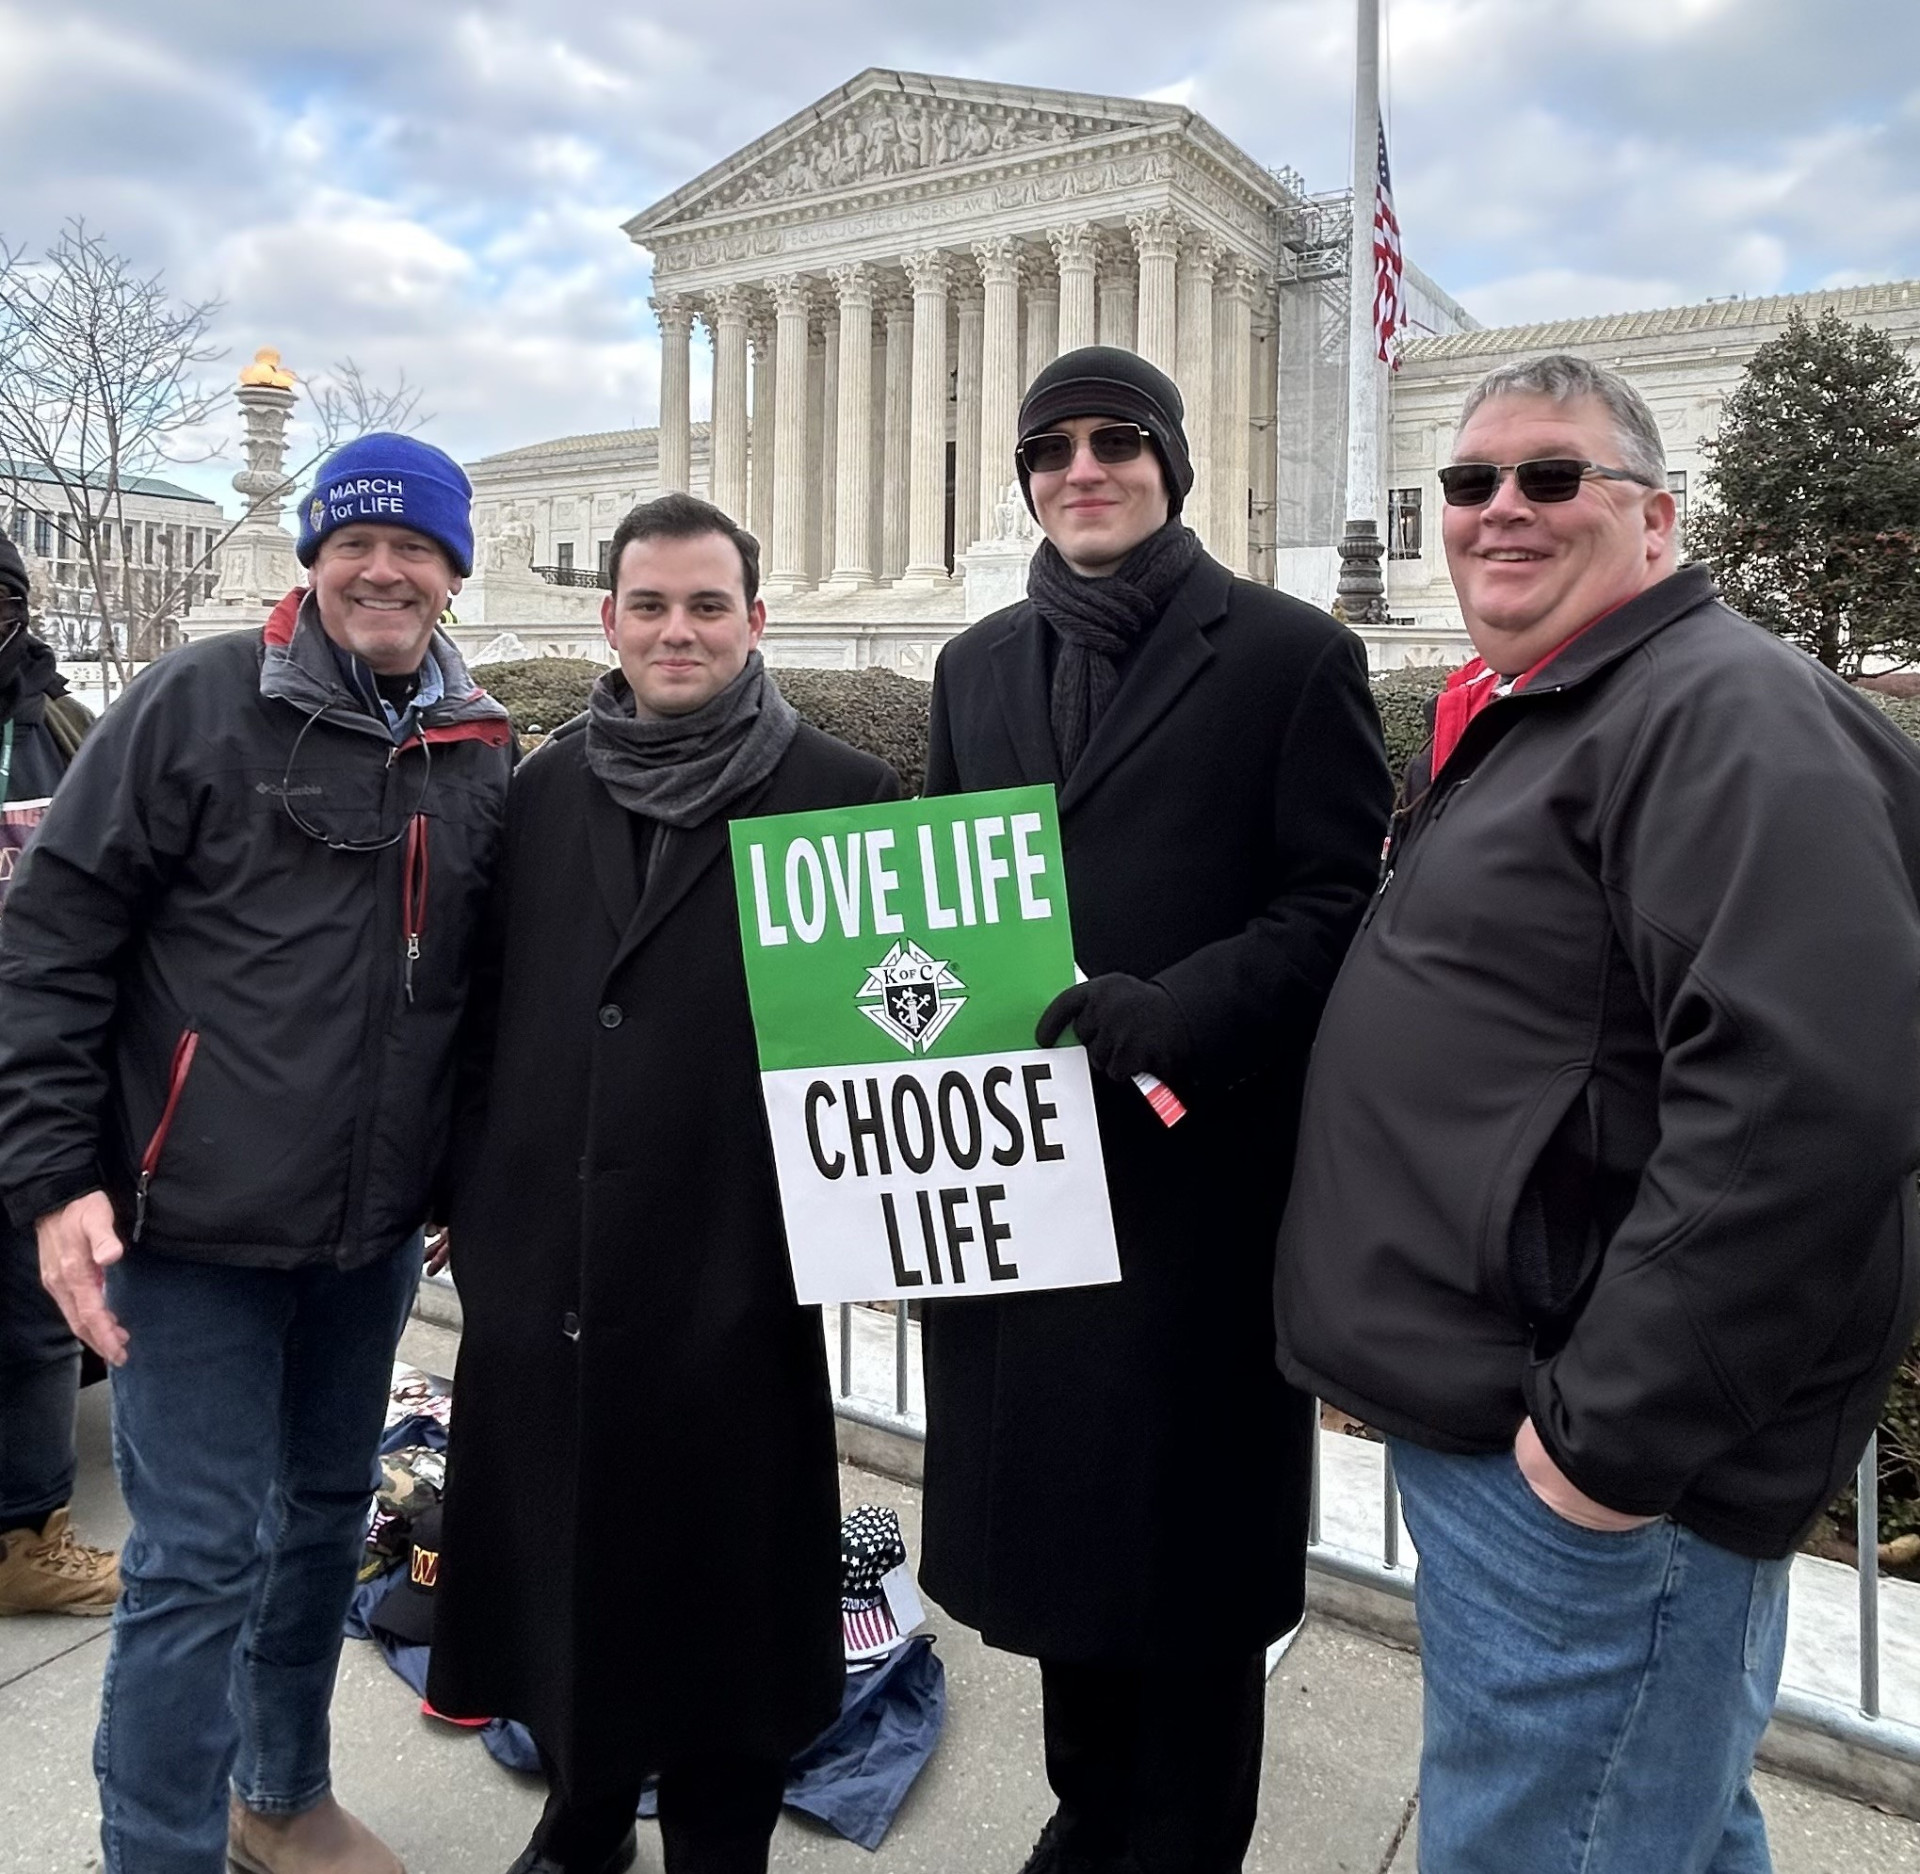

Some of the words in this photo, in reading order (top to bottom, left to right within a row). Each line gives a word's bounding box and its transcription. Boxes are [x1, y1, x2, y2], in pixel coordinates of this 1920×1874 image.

[791, 228, 838, 246] EQUAL
[842, 214, 893, 236] JUSTICE
[899, 203, 948, 224] UNDER
[954, 196, 985, 215] LAW
[329, 479, 403, 502] MARCH
[330, 503, 354, 521] for
[360, 497, 404, 514] LIFE
[750, 828, 905, 947] LOVE
[917, 812, 1052, 930] LIFE
[883, 968, 899, 985] K
[899, 969, 917, 980] OF
[920, 964, 934, 981] C
[805, 1063, 1065, 1180] CHOOSE
[880, 1184, 1019, 1287] LIFE
